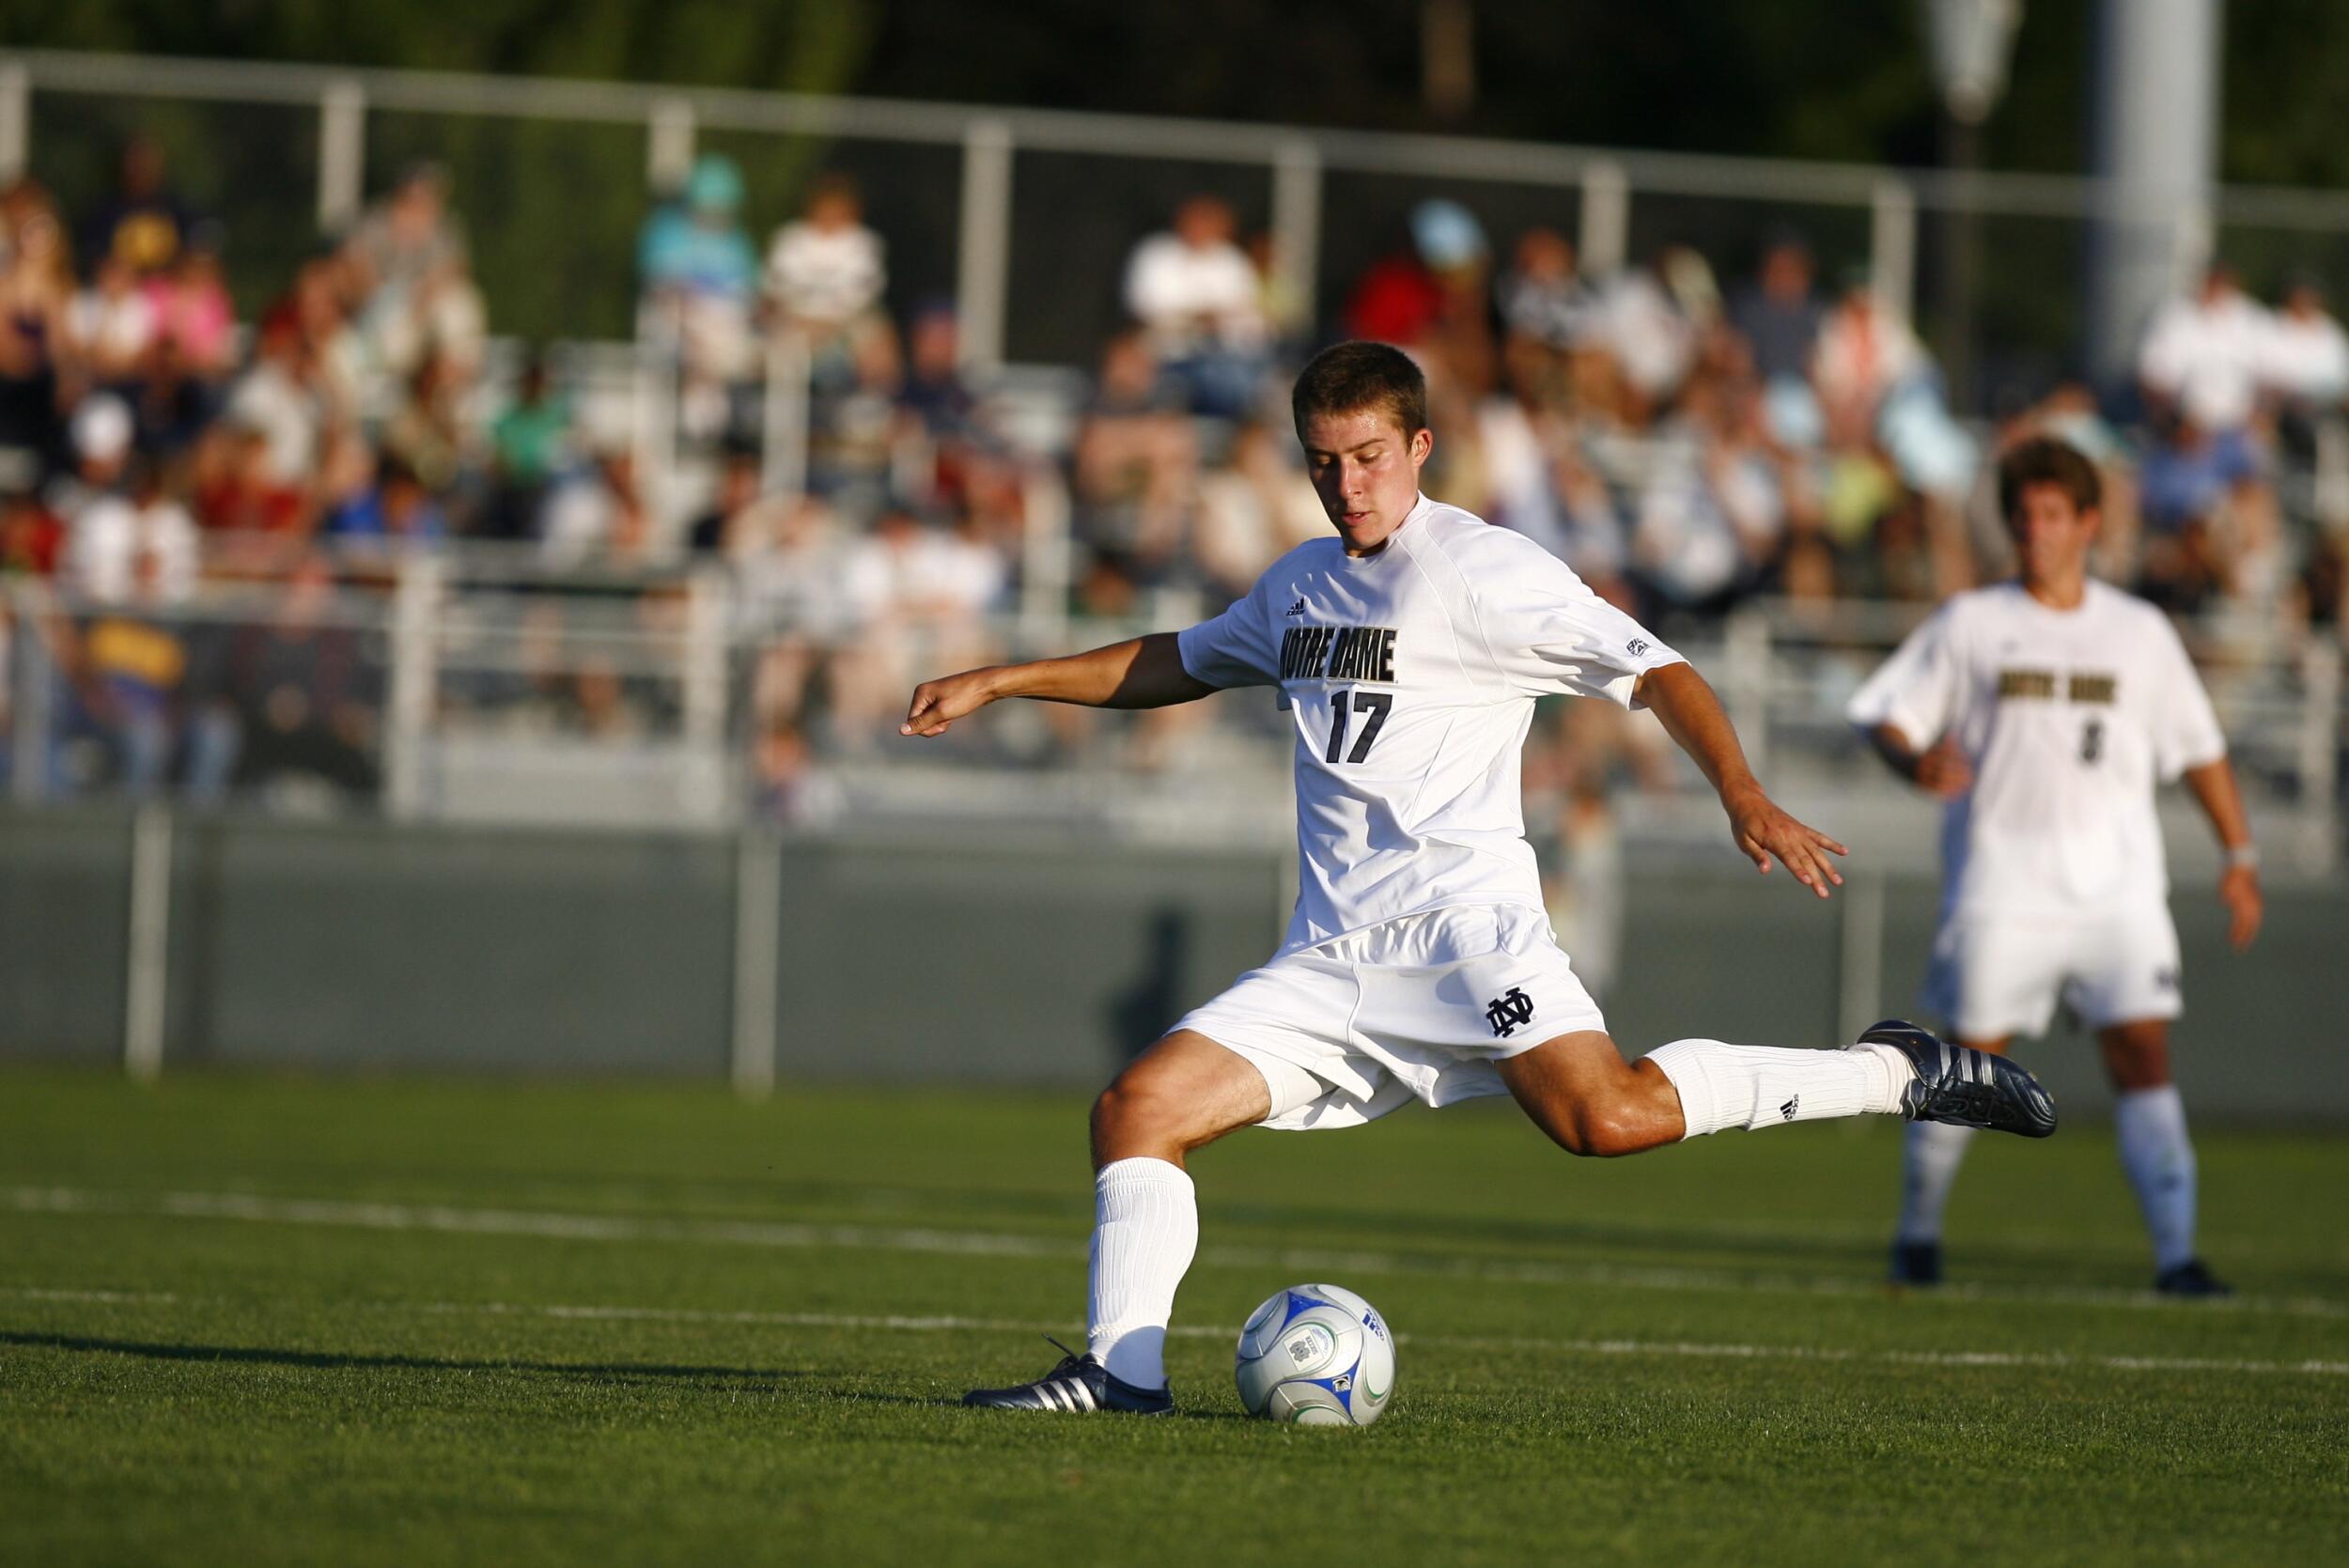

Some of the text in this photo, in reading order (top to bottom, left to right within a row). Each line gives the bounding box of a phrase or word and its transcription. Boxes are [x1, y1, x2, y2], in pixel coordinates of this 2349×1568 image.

[1279, 627, 1397, 682] NOTRE DAME
[1326, 691, 1392, 763] 17
